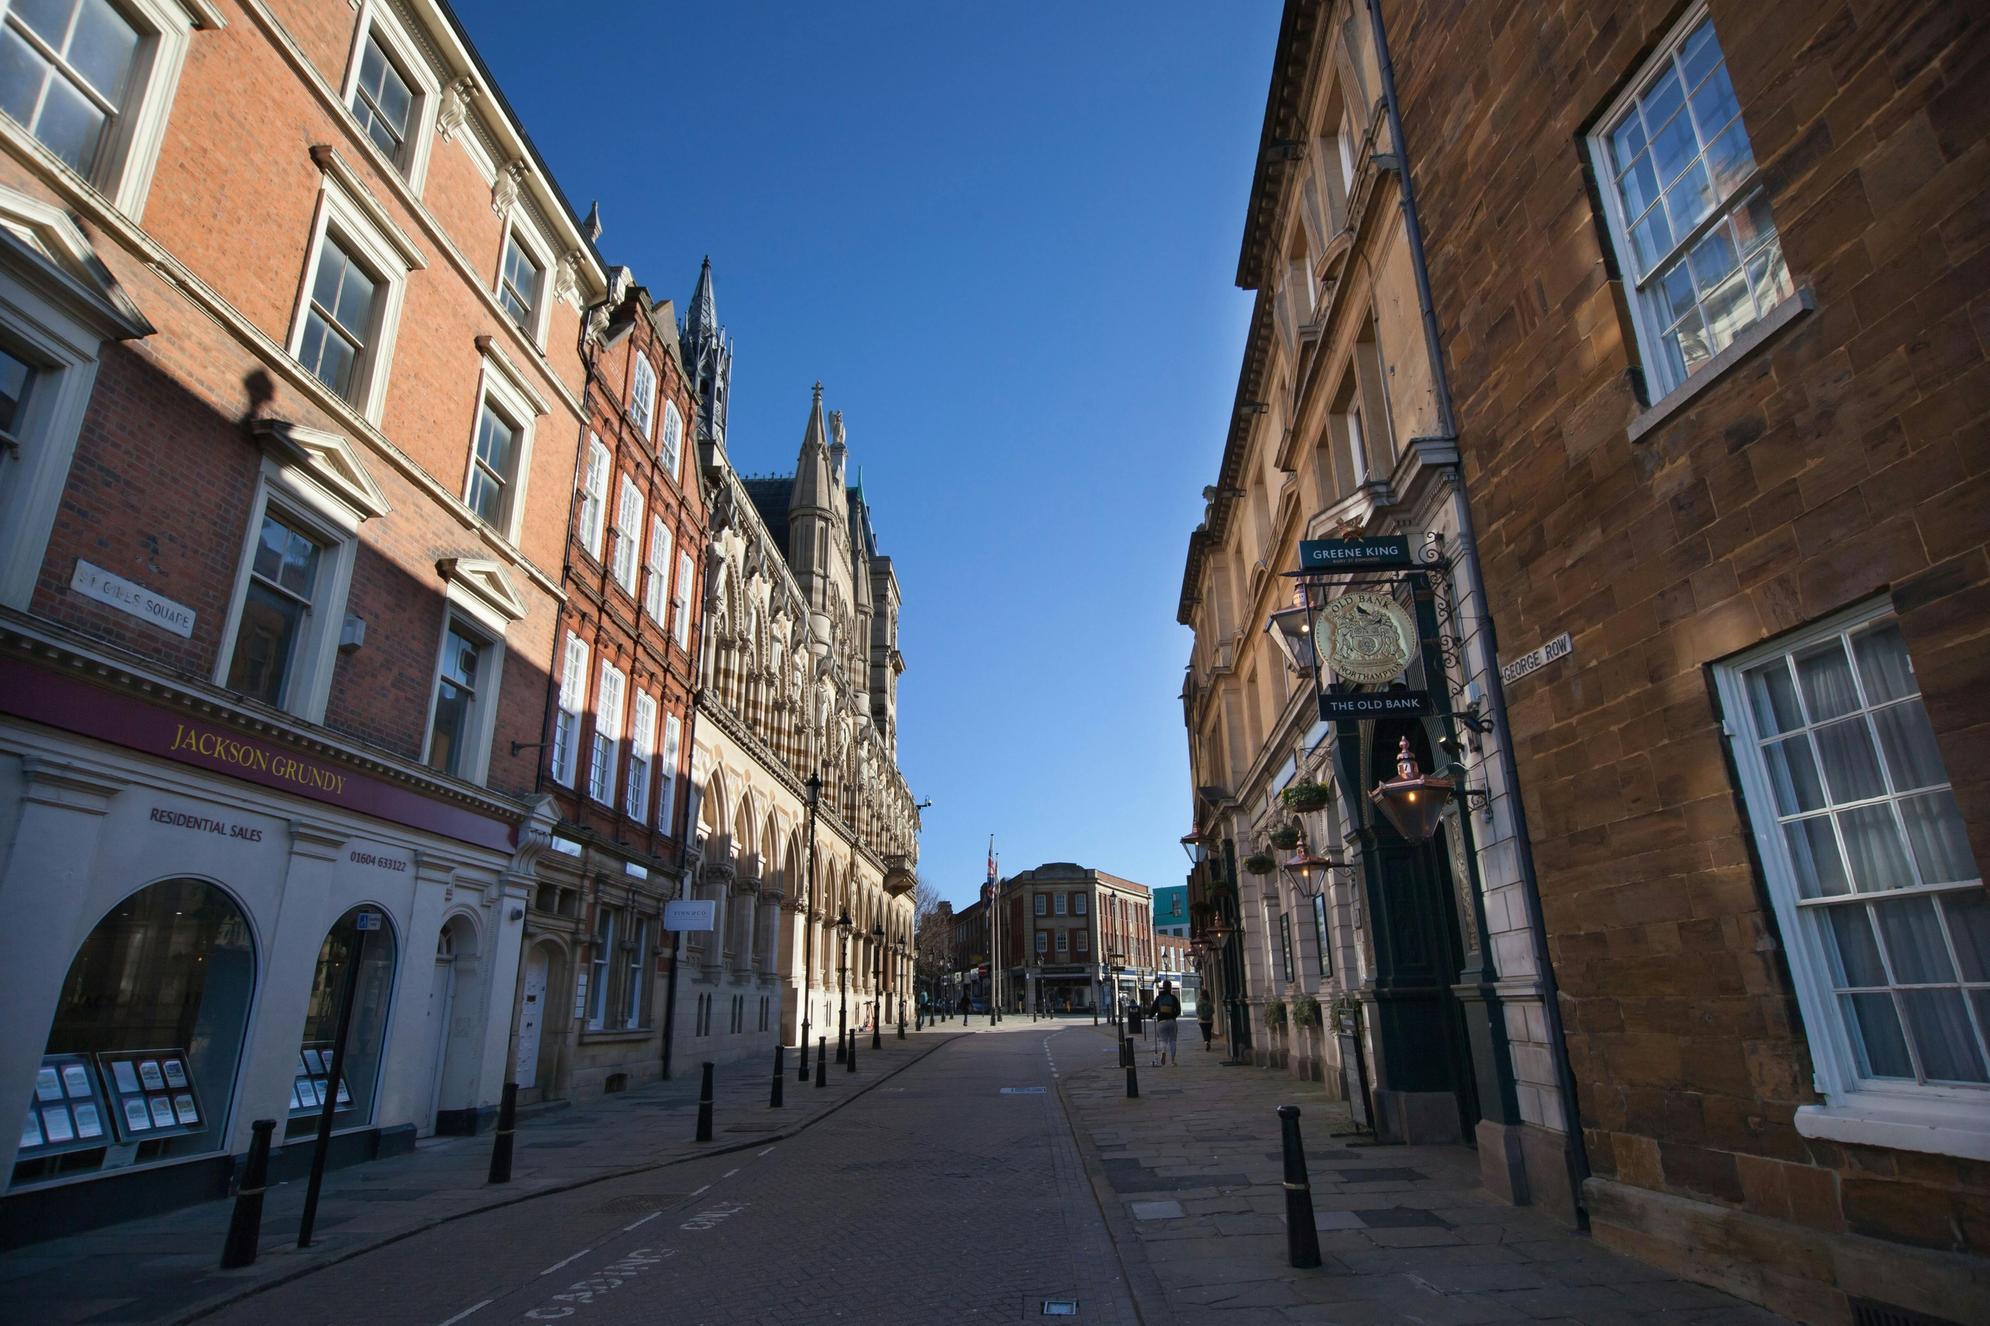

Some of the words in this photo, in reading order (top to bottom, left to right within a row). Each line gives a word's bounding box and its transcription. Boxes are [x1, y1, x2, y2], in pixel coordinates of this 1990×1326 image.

[1313, 548, 1362, 559] GREENE
[1366, 546, 1399, 556] KING
[145, 599, 190, 629] SQUARE
[1331, 596, 1354, 613] OLD
[1358, 595, 1391, 610] BANK
[1504, 651, 1541, 681] GEORGE
[1545, 635, 1567, 660] ROW
[1338, 662, 1404, 680] NORTHAMPTON
[1330, 701, 1354, 711] THE
[1357, 700, 1383, 710] OLD
[1386, 698, 1420, 709] BANK
[171, 724, 270, 771] JACKSON
[272, 756, 347, 795] GRUNDY
[150, 808, 227, 836] RESIDENTIAL
[230, 825, 263, 843] SALES
[350, 851, 376, 866] 01604
[525, 1248, 680, 1326] OADING
